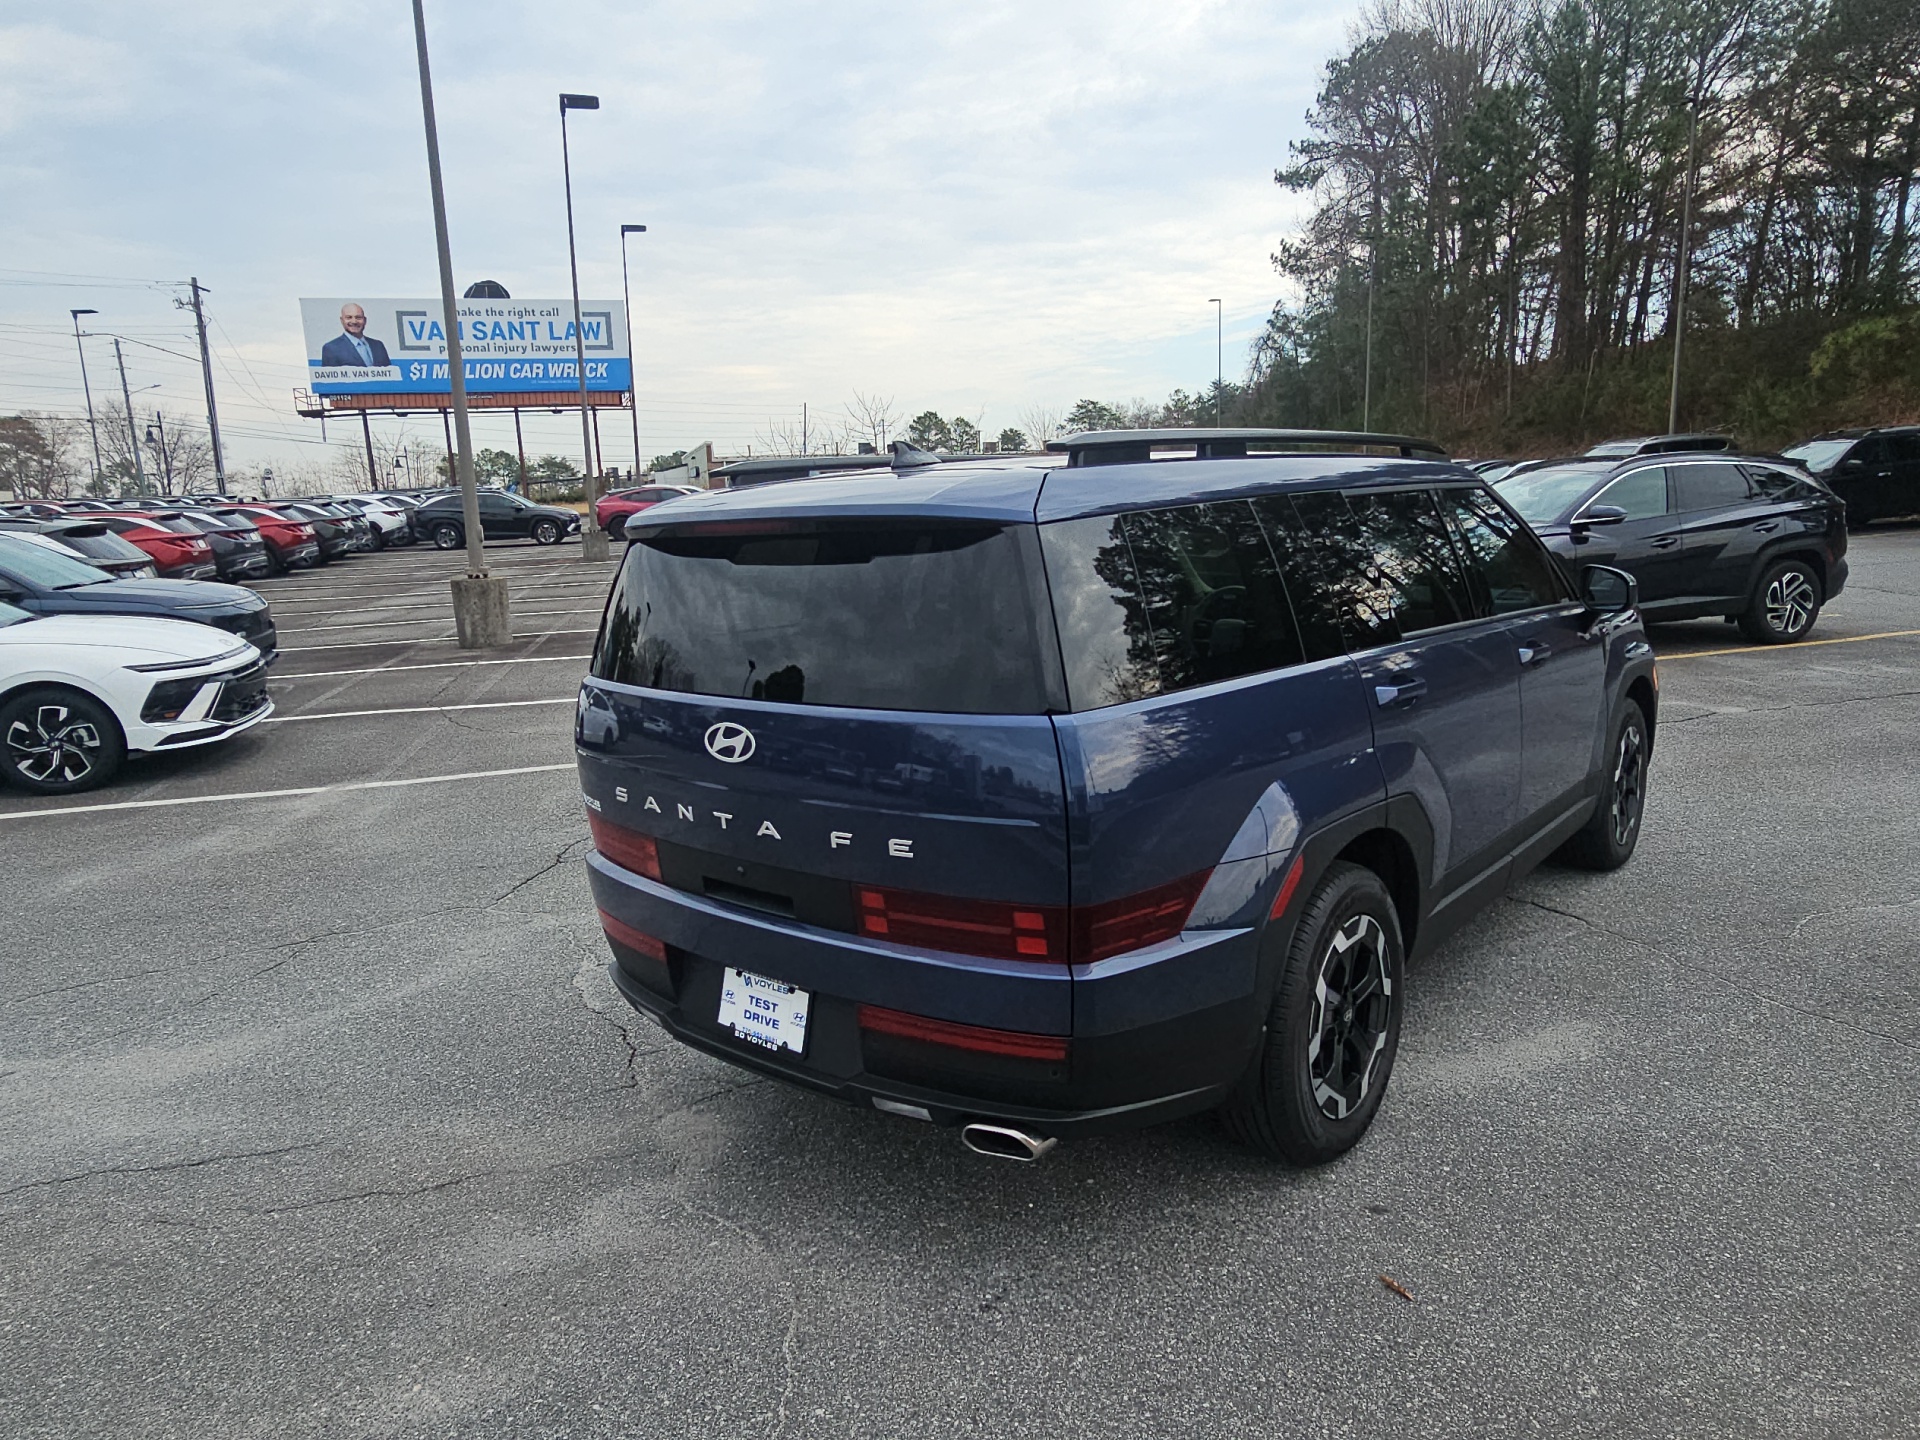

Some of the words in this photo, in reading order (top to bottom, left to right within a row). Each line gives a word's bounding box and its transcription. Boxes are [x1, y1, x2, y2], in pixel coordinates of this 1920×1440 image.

[485, 307, 505, 317] the
[507, 307, 536, 320] right
[539, 307, 560, 317] call
[472, 320, 540, 341] SANT
[548, 321, 601, 341] LAW
[438, 342, 491, 355] psonal
[494, 342, 528, 355] injury
[531, 342, 577, 355] lawyers
[314, 371, 339, 379] DAVID
[352, 370, 369, 378] VAN
[371, 370, 392, 378] SANT
[409, 362, 428, 381] $1
[432, 363, 506, 379] MLION
[509, 363, 544, 379] CAR
[615, 786, 782, 840] SANTA
[830, 831, 914, 858] FE
[753, 978, 789, 995] VOYLES
[748, 995, 779, 1013] TEST
[743, 1009, 780, 1030] DRIVE
[746, 1035, 778, 1051] VOYLES
